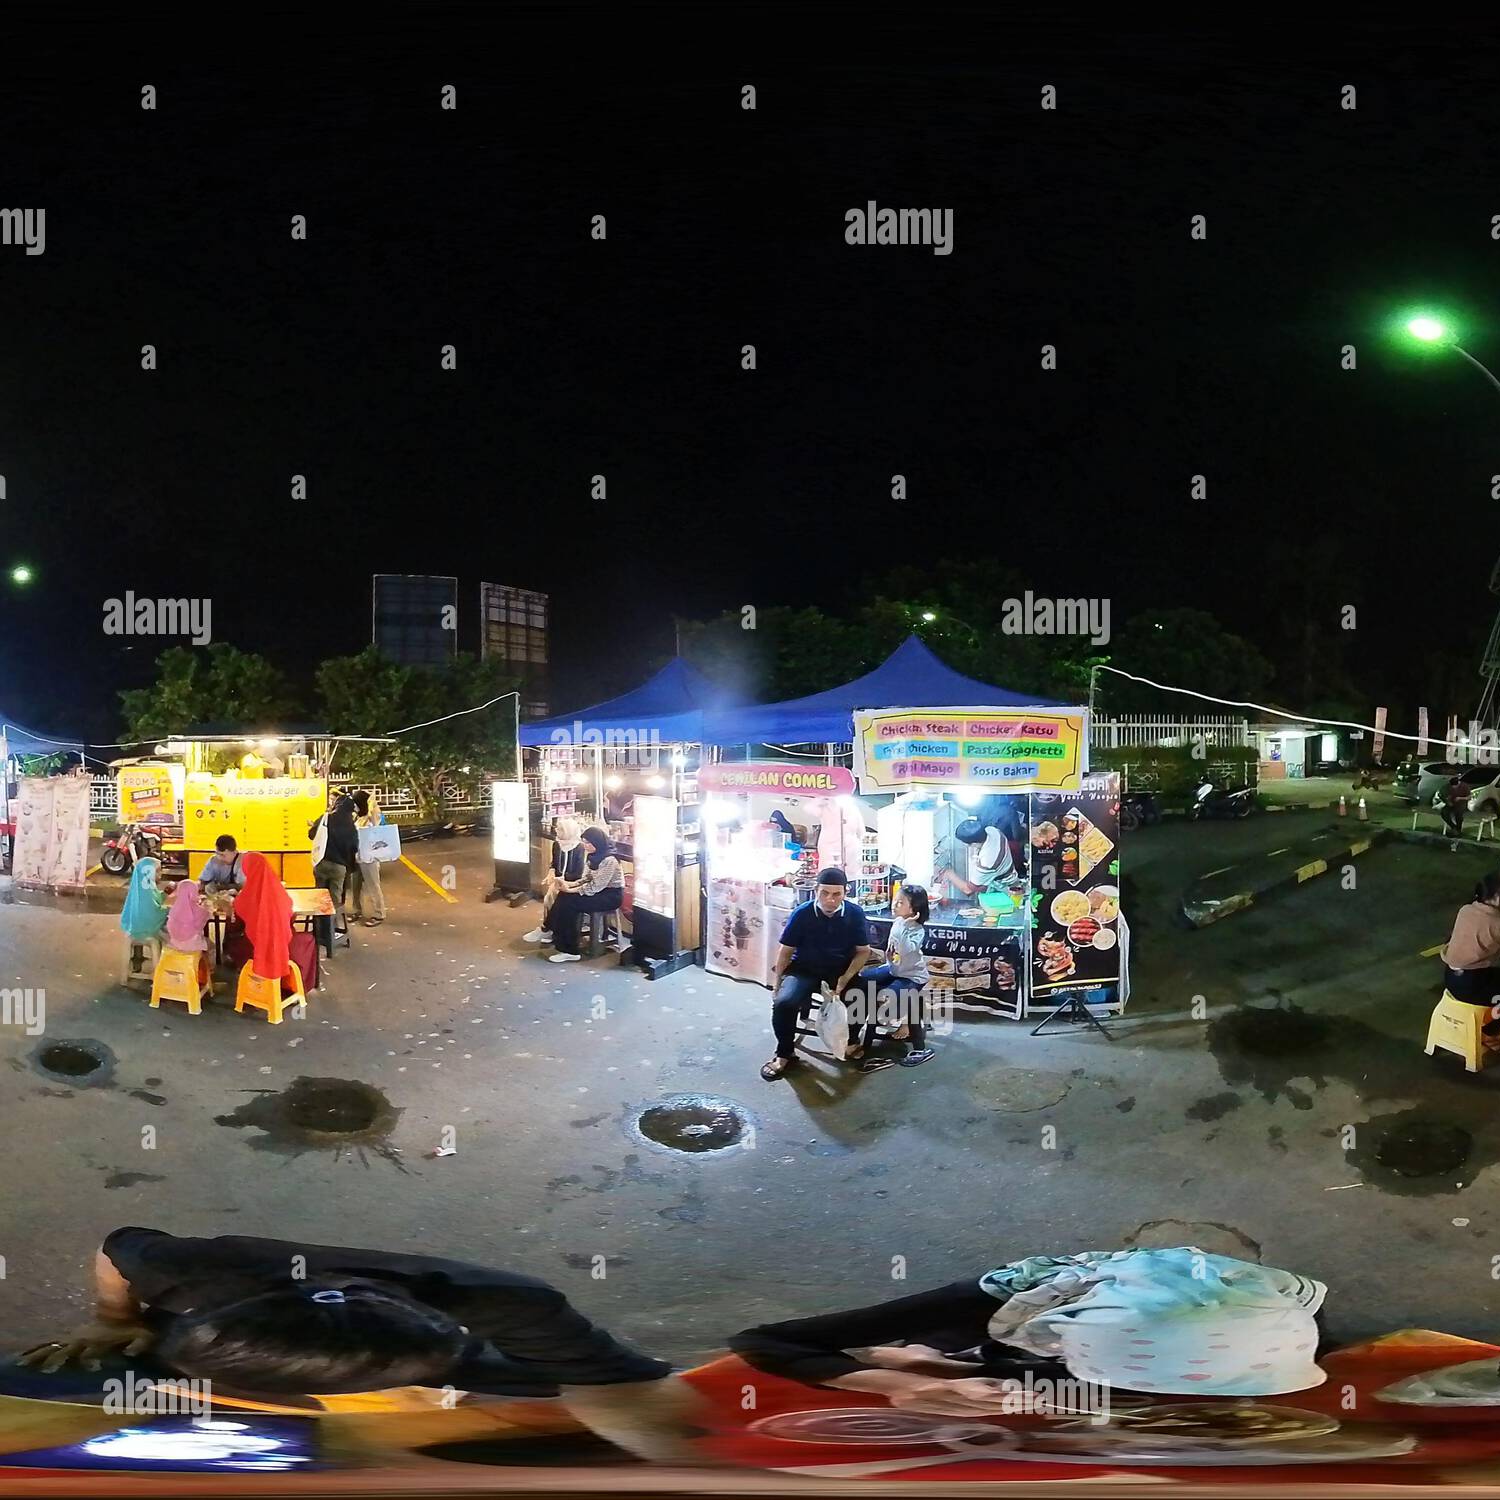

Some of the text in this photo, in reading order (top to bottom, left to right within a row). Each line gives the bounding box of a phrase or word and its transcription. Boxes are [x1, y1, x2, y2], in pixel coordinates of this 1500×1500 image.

[926, 723, 959, 733] Steak
[1021, 724, 1054, 736] Katsu
[920, 763, 954, 776] Mayo
[973, 765, 999, 776] Sosis
[1003, 766, 1035, 776] Bakar
[782, 772, 837, 790] COMEL
[1081, 779, 1108, 791] EDAI
[928, 928, 967, 941] KEDAI
